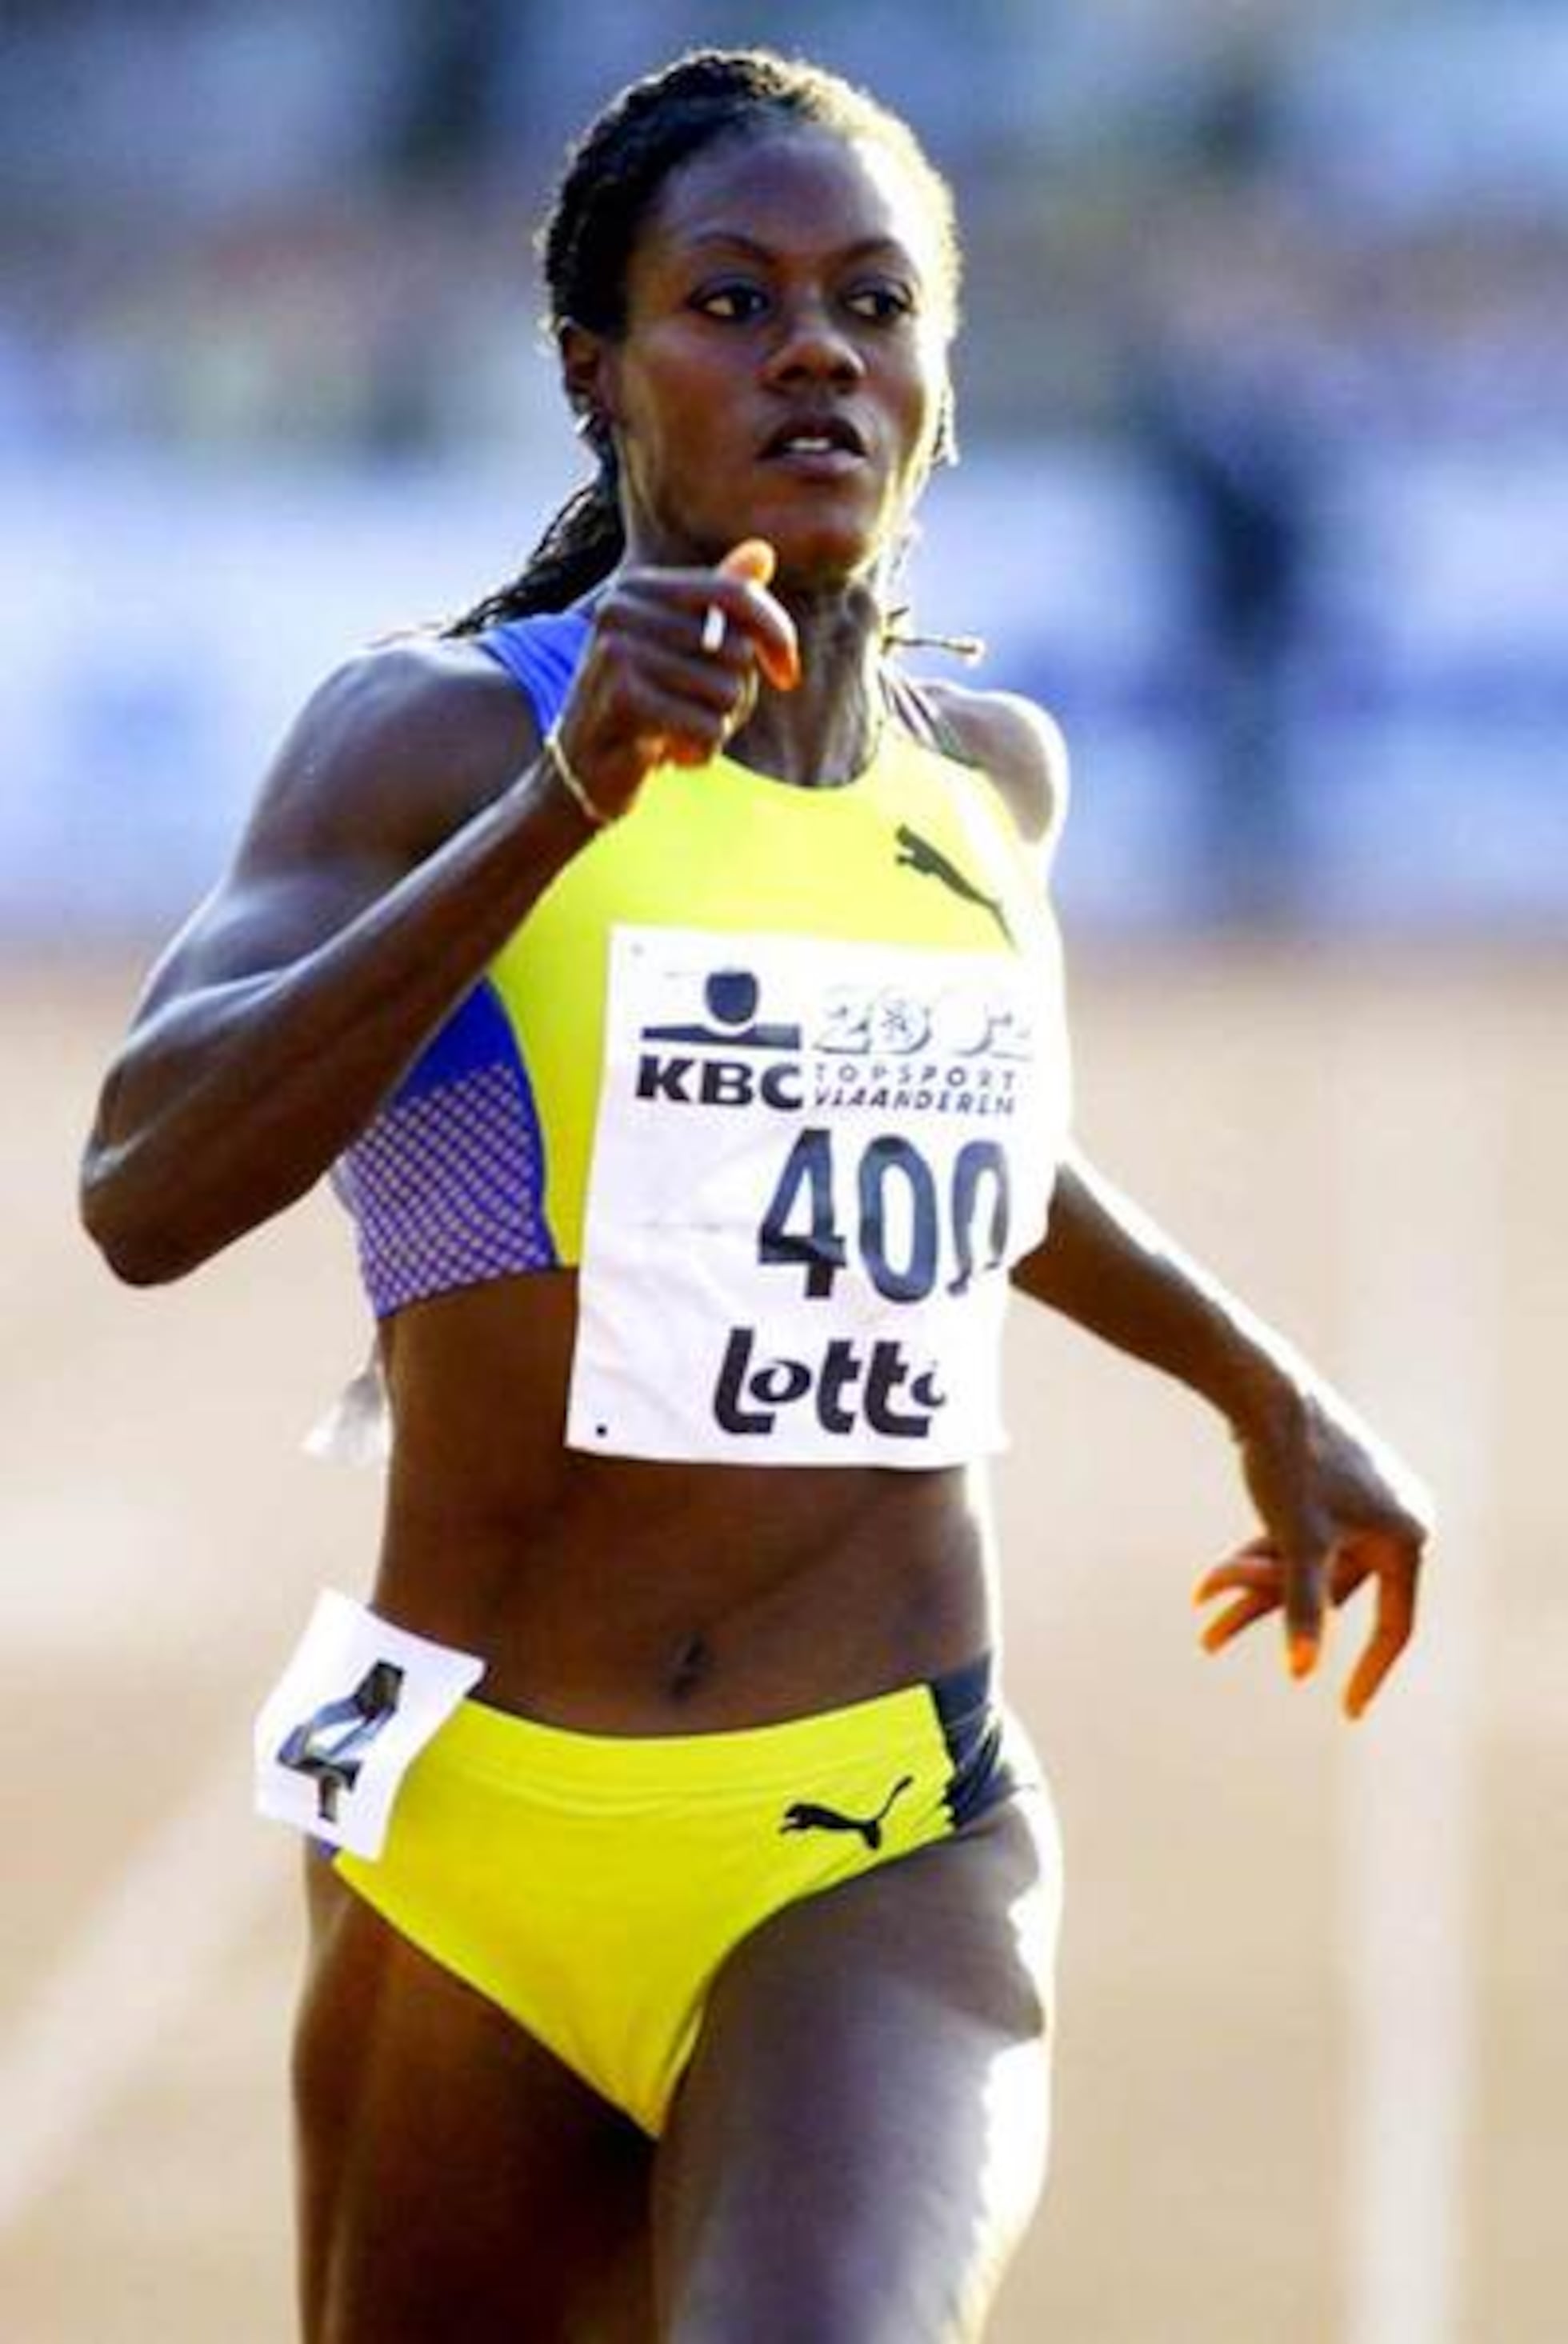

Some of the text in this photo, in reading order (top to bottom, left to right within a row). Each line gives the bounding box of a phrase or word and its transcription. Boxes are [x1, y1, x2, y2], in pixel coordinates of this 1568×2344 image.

[636, 1054, 803, 1111] KBC
[814, 1062, 1015, 1090] TOPSPORT
[814, 1086, 1015, 1115] VLAANDEREN
[758, 1127, 1010, 1302] 400
[276, 1658, 404, 1825] 4
